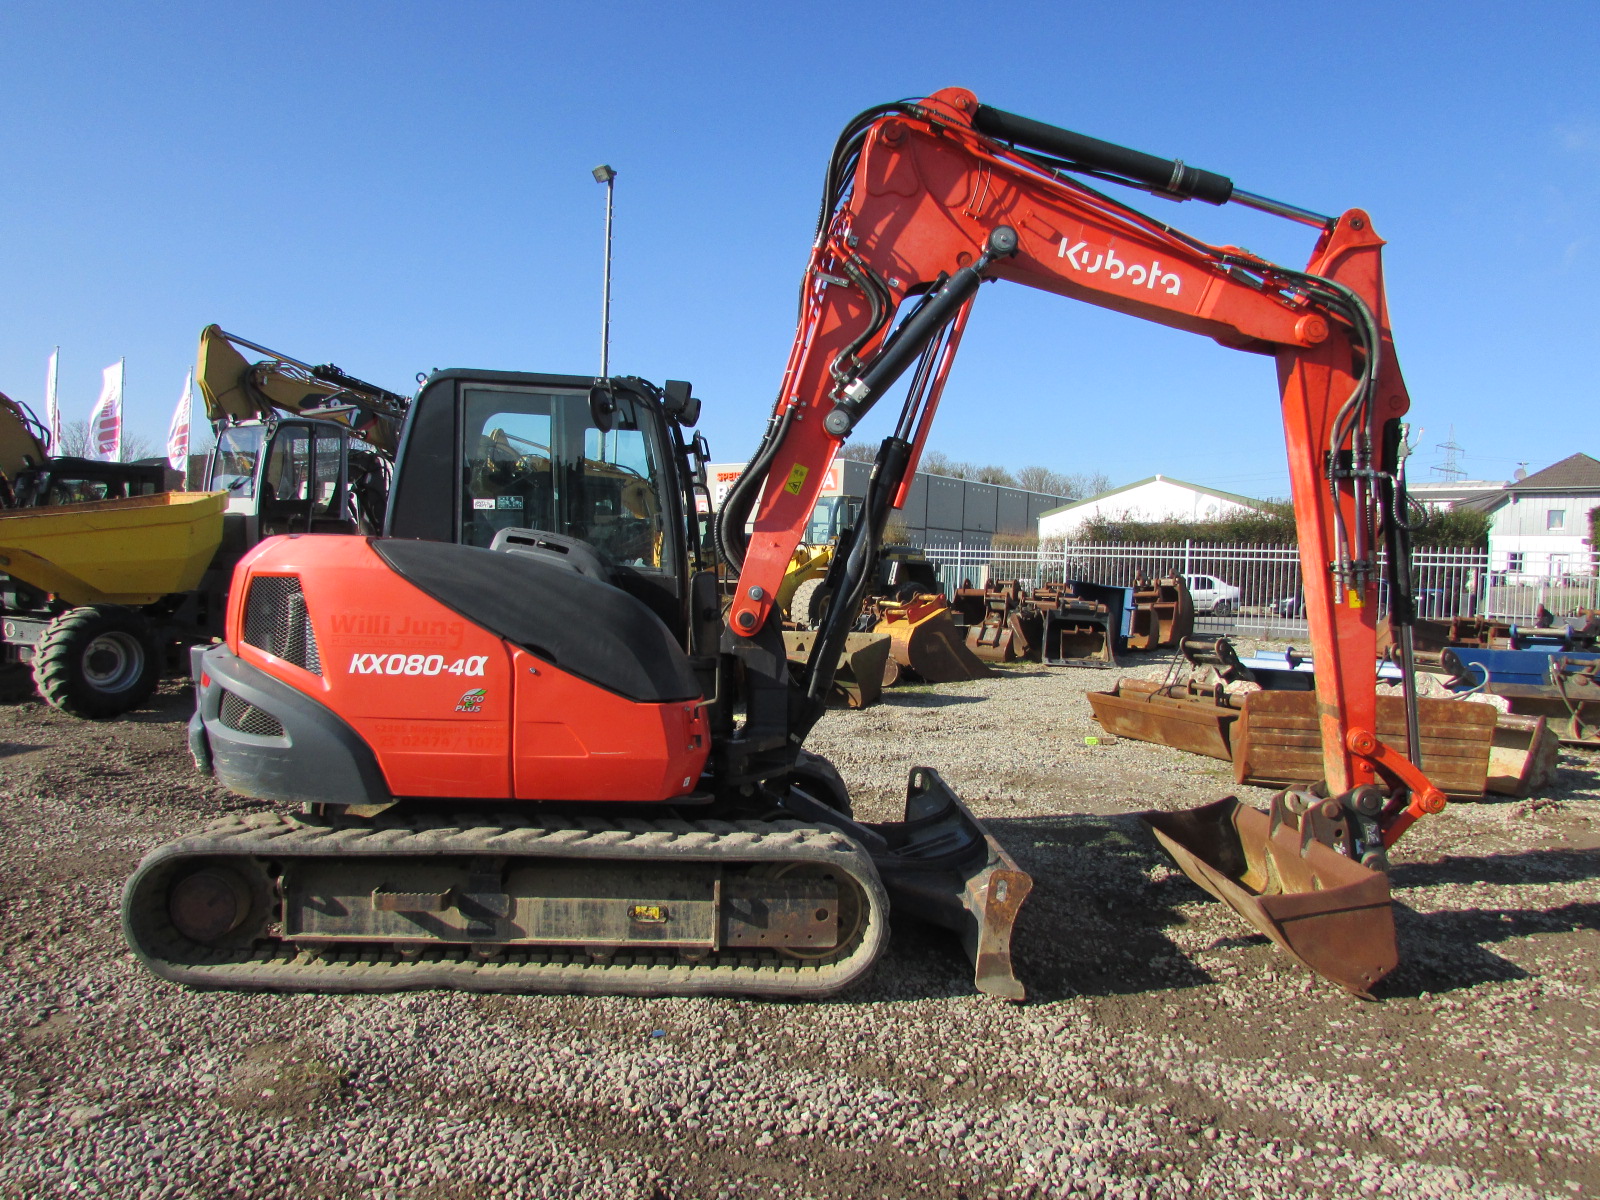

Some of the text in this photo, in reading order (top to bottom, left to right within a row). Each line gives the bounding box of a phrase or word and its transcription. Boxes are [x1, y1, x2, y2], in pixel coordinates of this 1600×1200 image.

[1058, 237, 1181, 295] Kubota
[331, 614, 464, 650] Willi Jung
